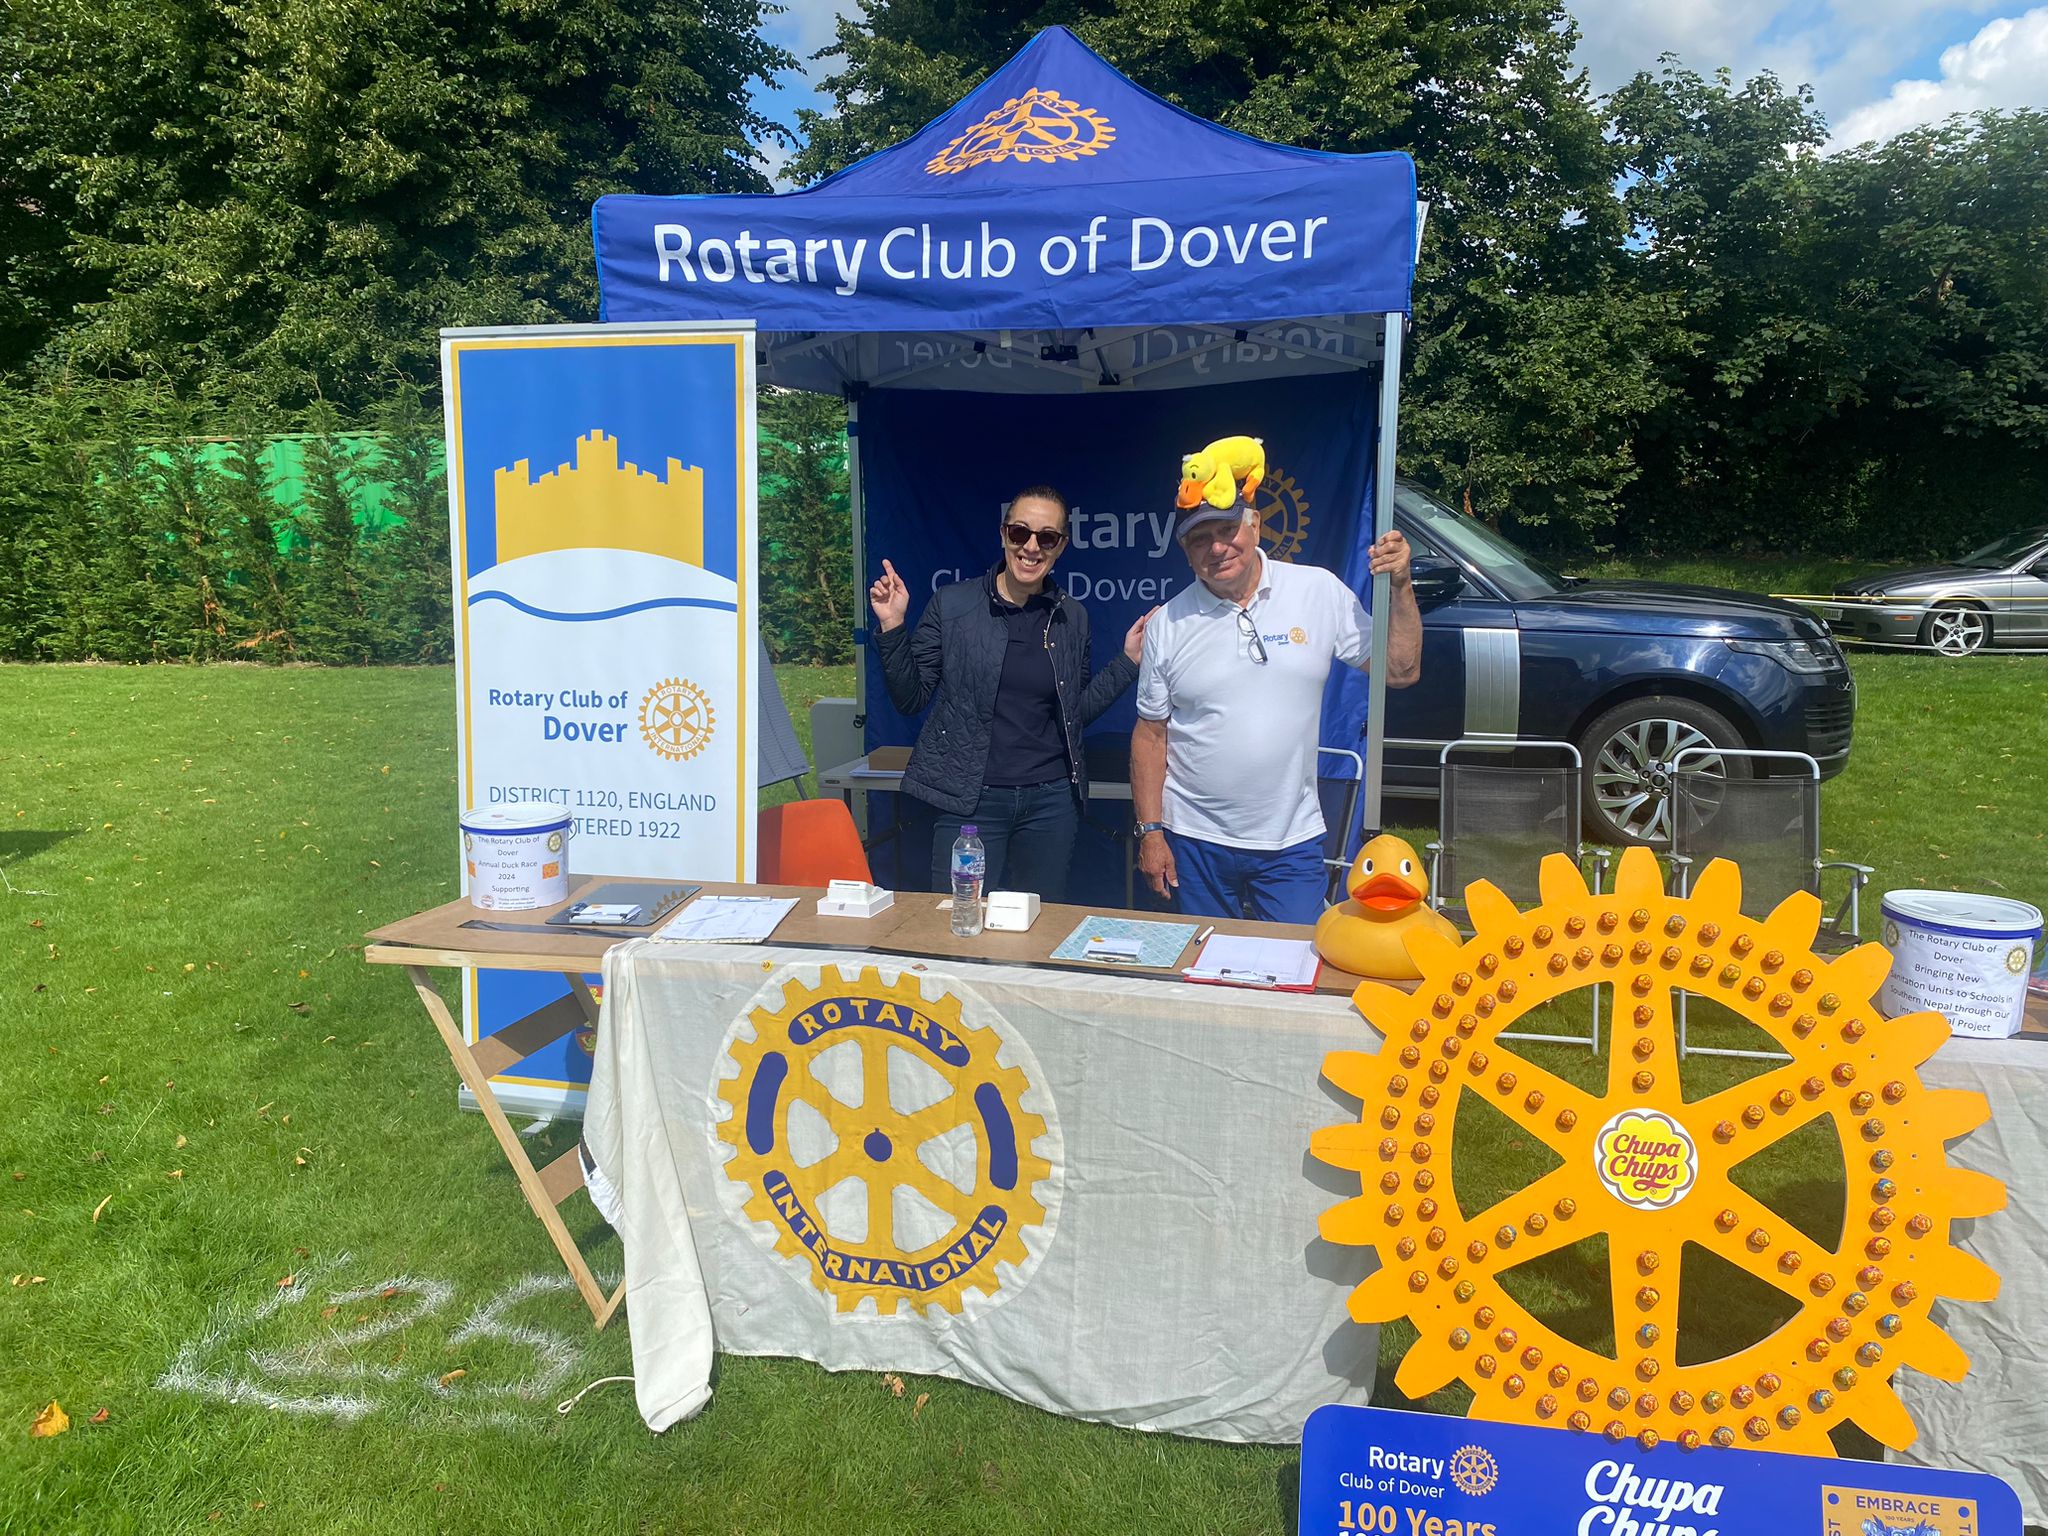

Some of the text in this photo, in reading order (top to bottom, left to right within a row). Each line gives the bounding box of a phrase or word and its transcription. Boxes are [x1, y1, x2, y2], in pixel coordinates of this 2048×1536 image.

[654, 215, 1328, 296] Rotary Club of Dover
[1001, 503, 1176, 558] tary
[1068, 571, 1173, 601] Dover
[1262, 633, 1289, 643] Rotary
[488, 689, 628, 711] Rotary Club of
[660, 686, 693, 697] ROTARY
[543, 715, 628, 742] Dover
[649, 731, 704, 753] INTERNATIONAL
[489, 786, 716, 812] DISTRICT 1120, ENGLAND
[478, 836, 489, 844] The
[491, 837, 513, 846] Rotary
[573, 817, 681, 839] TERED 1922
[478, 860, 499, 868] Annual
[521, 860, 538, 868] Race
[492, 885, 530, 894] Supporting
[1909, 930, 1998, 953] The Rotary Club of
[1933, 951, 1965, 964] Dover
[1890, 969, 2013, 1004] Sanitation Units to Schools in
[1914, 963, 1981, 984] Bringing New
[1890, 984, 1921, 1004] Southern
[1923, 998, 1953, 1012] Nepal
[1954, 1004, 1992, 1018] through
[1994, 1010, 2010, 1020] our
[796, 999, 964, 1053] ROTARY
[1957, 1018, 1992, 1032] Project
[1613, 1133, 1682, 1161] Chupa
[1609, 1155, 1679, 1191] Chups
[768, 1180, 1004, 1289] INTERNATIONAL
[1368, 1445, 1445, 1480] Rotary
[1339, 1472, 1374, 1490] Club
[1378, 1477, 1395, 1493] of
[1399, 1479, 1445, 1499] Dover
[1584, 1459, 1725, 1522] Chupa
[1338, 1500, 1498, 1536] 100 Years
[1856, 1495, 1941, 1516] EMBRACE
